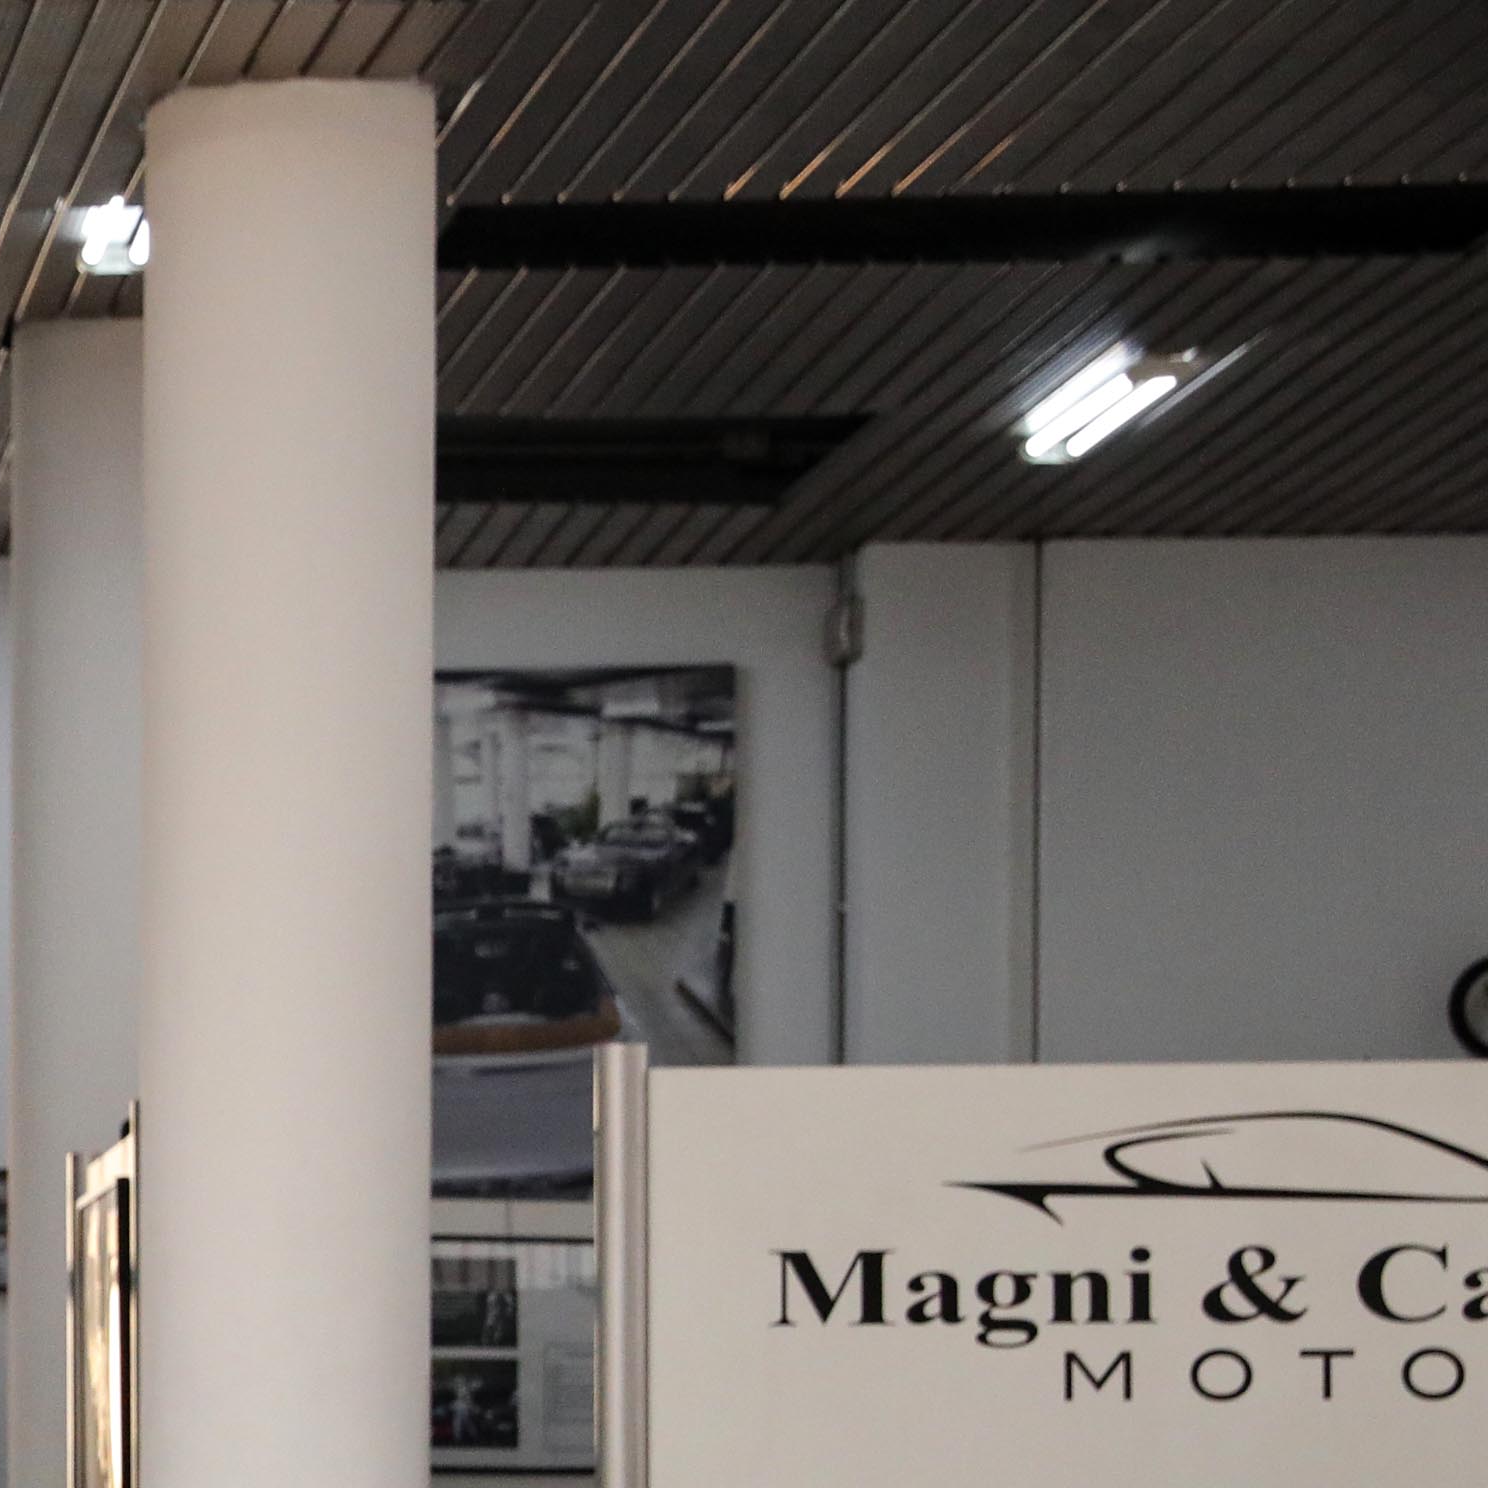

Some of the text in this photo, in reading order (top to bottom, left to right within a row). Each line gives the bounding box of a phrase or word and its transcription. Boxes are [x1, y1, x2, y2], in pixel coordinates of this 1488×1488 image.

[770, 1246, 1159, 1350] Magni
[1201, 1245, 1308, 1325] &
[1062, 1348, 1466, 1401] MOTO
